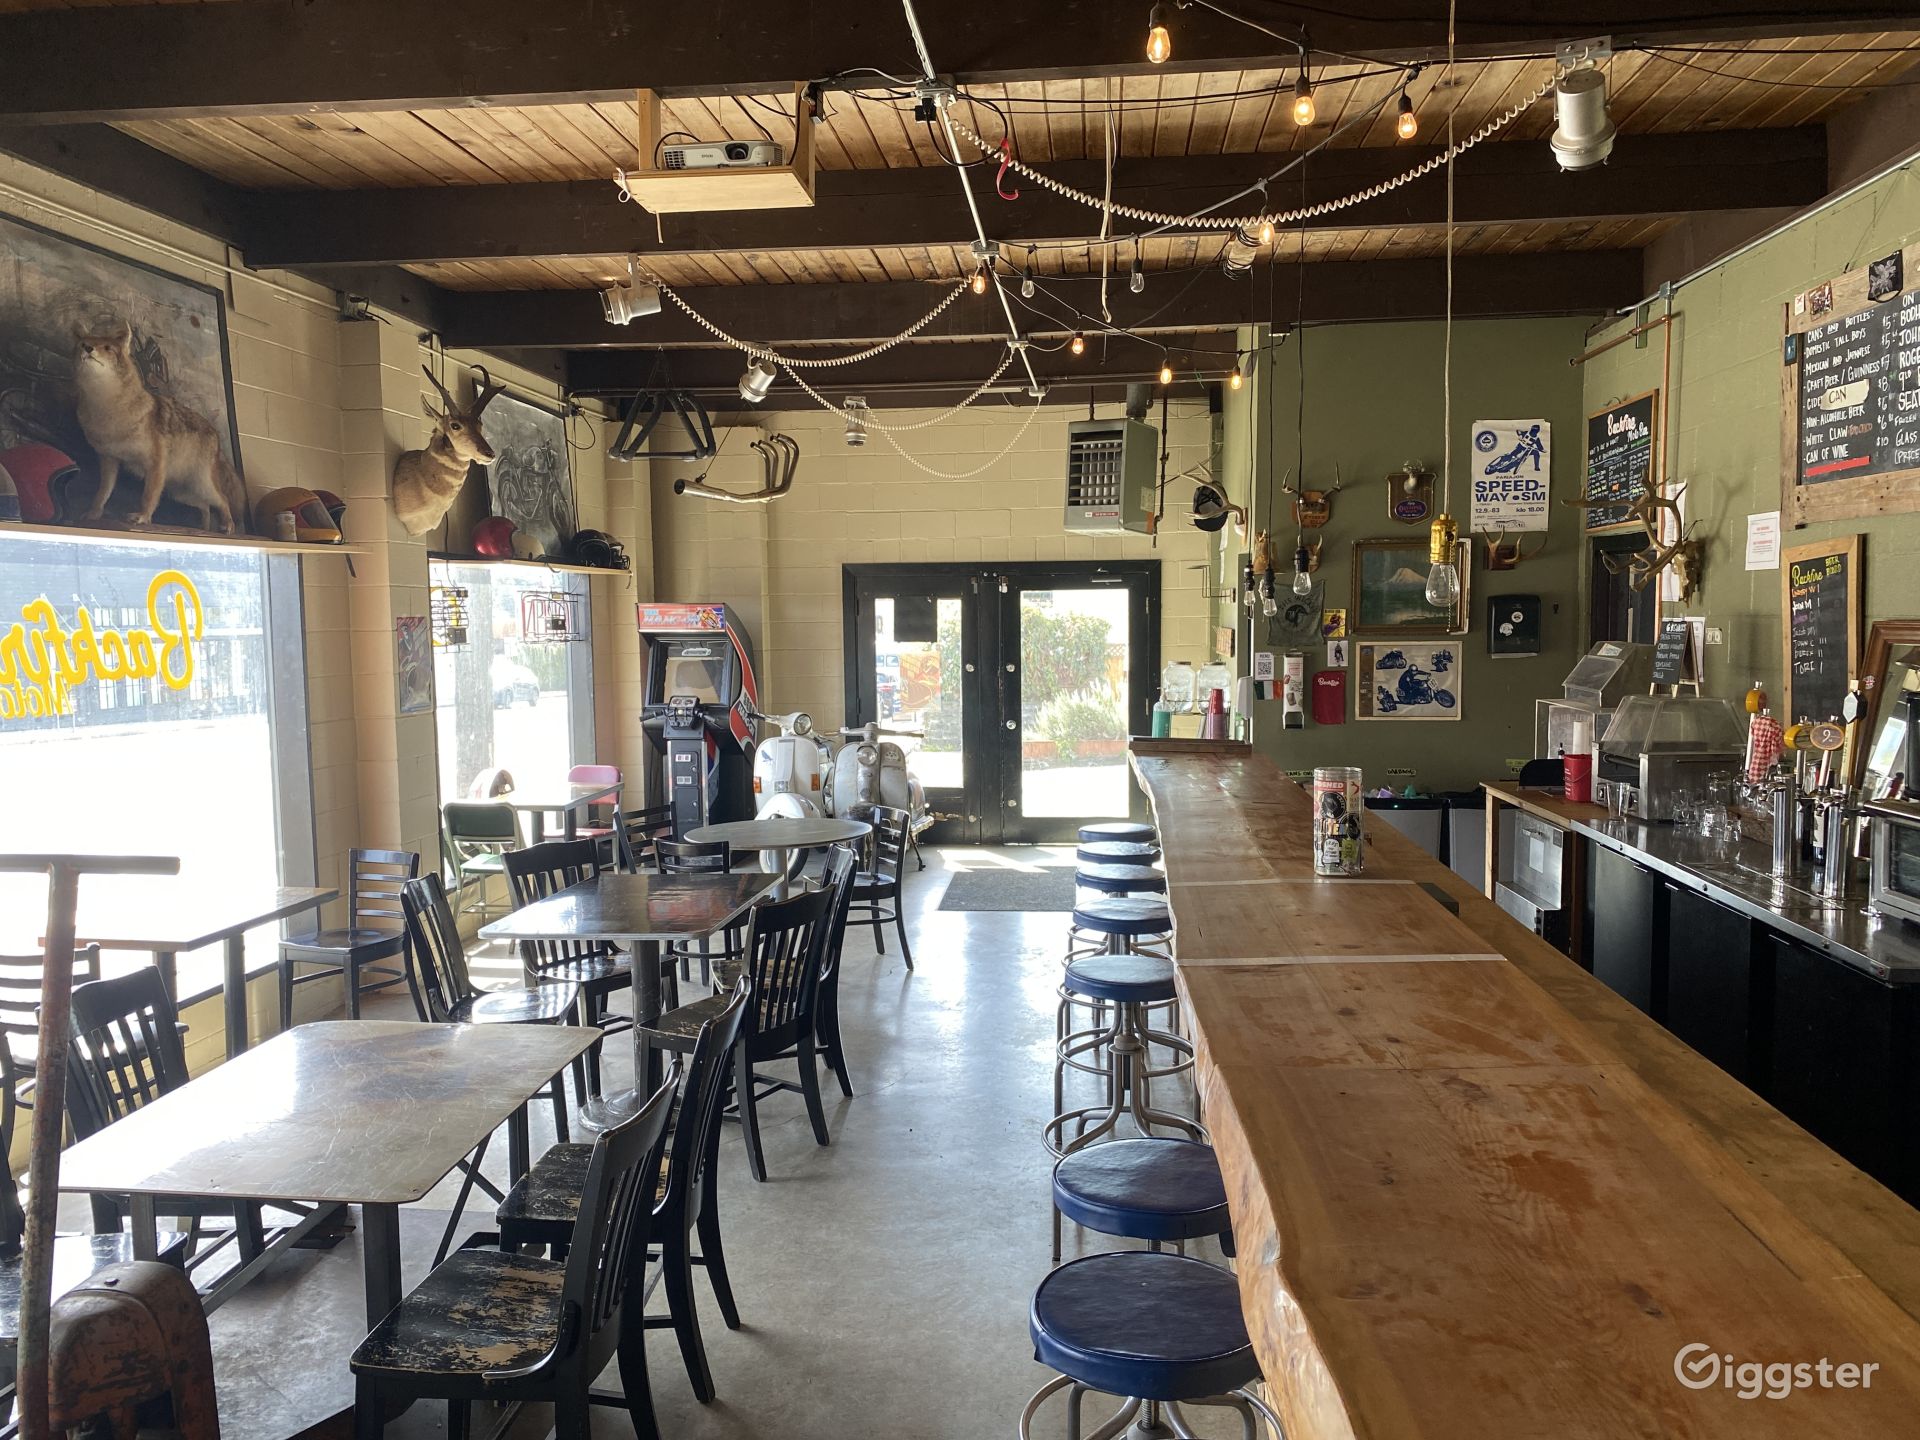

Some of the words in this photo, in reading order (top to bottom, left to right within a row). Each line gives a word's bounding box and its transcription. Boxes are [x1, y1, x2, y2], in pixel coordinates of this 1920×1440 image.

[1902, 292, 1915, 307] ON
[1807, 328, 1824, 343] CANS
[1827, 323, 1840, 335] AND
[1845, 309, 1875, 328] BOTTLES:
[1900, 304, 1920, 327] BODH
[1805, 341, 1830, 359] DOMESTIC
[1834, 334, 1850, 348] TALL
[1851, 328, 1866, 341] BOYS
[1805, 358, 1829, 376] MEXICAN
[1832, 355, 1842, 367] AND
[1806, 377, 1824, 392] CRAFT
[1824, 374, 1839, 389] BEER
[1847, 360, 1880, 381] GUINNESS
[1806, 395, 1823, 411] CIDE
[1828, 386, 1847, 404] CAN
[1898, 388, 1920, 411] SEAT
[1848, 404, 1866, 419] BEER
[1806, 432, 1824, 447] WHITE
[1829, 425, 1848, 441] CLAW
[1895, 428, 1918, 447] GLASS
[1806, 448, 1820, 464] CAN
[1821, 446, 1830, 460] OF
[1831, 443, 1849, 459] WINE
[1475, 479, 1546, 493] SPEED-
[1475, 492, 1510, 502] WAY
[1521, 491, 1546, 501] SM
[1791, 564, 1823, 587] Backfire
